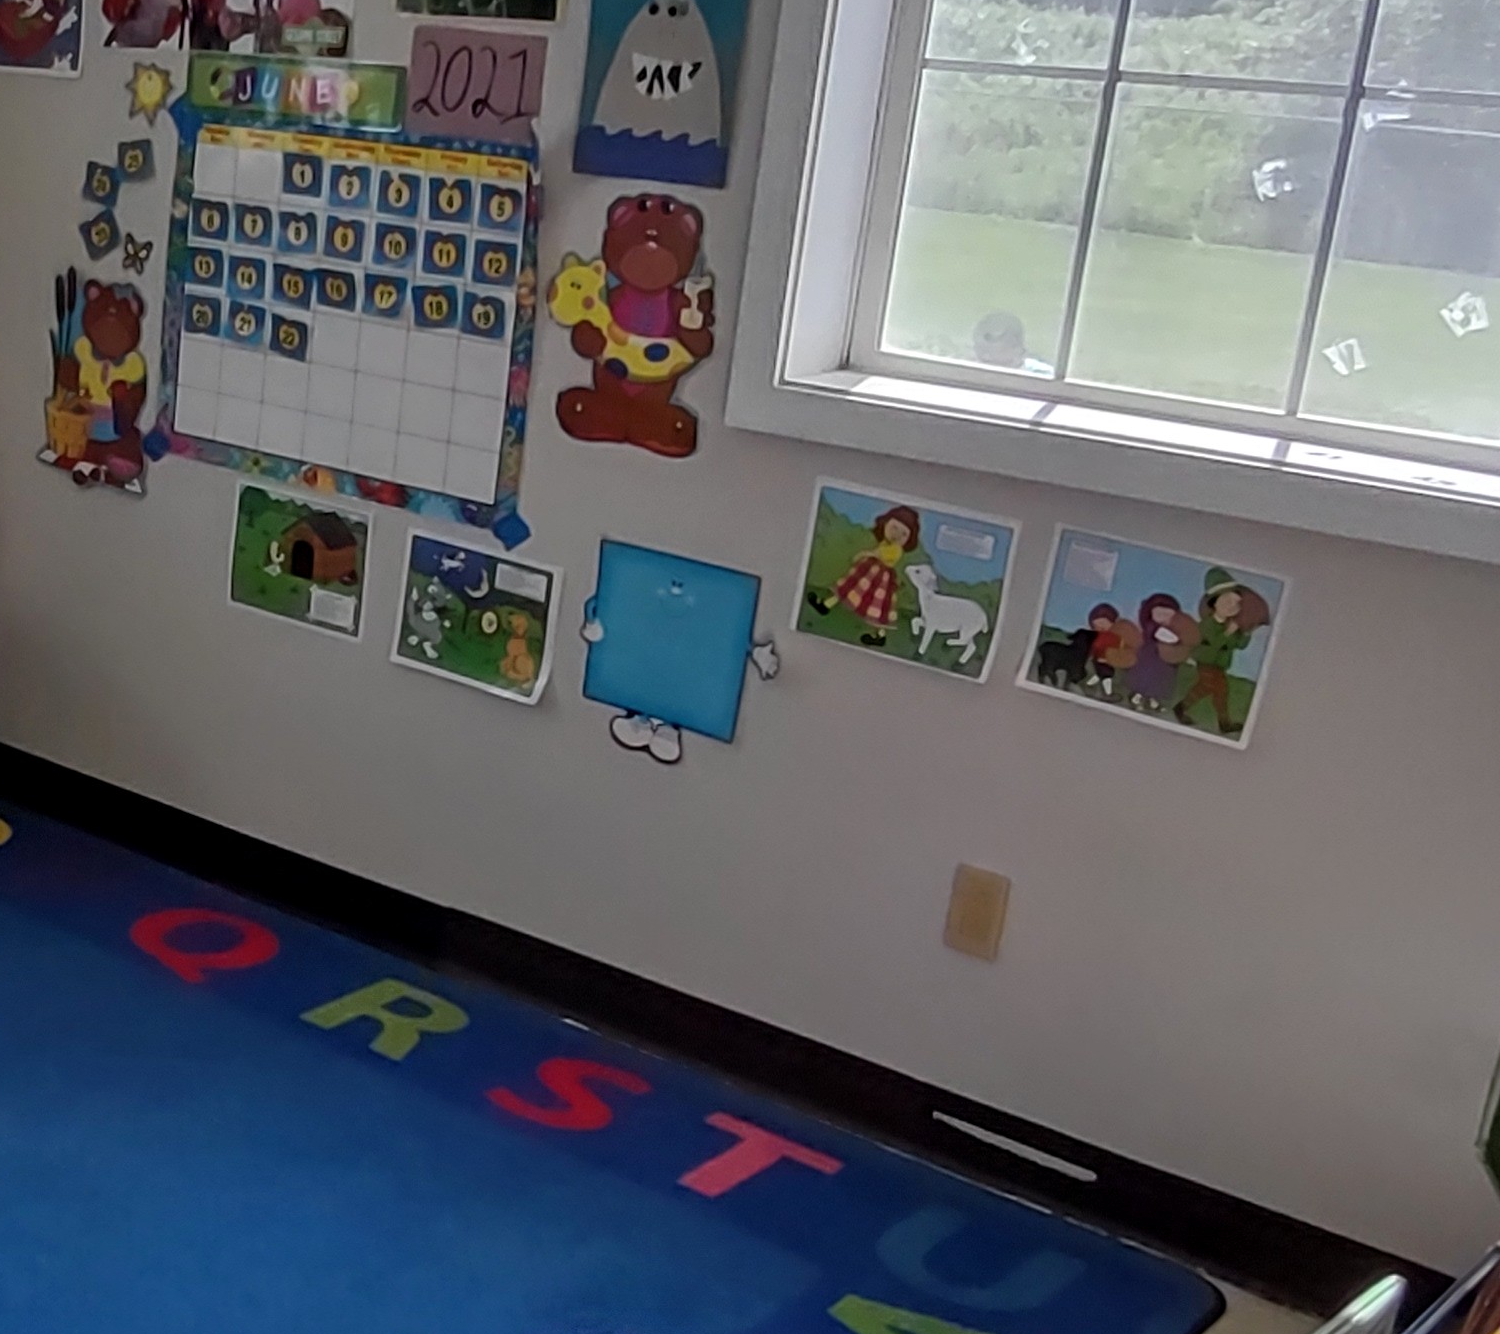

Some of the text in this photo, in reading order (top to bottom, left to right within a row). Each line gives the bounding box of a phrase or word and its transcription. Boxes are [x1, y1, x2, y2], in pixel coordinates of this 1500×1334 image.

[236, 73, 334, 105] JUNE
[411, 39, 541, 125] 2021
[387, 238, 403, 255] 10
[437, 246, 453, 263] 11
[487, 255, 503, 273] 12
[238, 315, 253, 333] 21
[239, 268, 254, 285] 14
[286, 276, 301, 293] 15
[377, 287, 394, 305] 17
[428, 298, 444, 316] 18
[475, 307, 492, 325] 19
[129, 907, 281, 984] Q
[300, 977, 470, 1061] R
[485, 1057, 653, 1132] S
[677, 1111, 844, 1198] T
